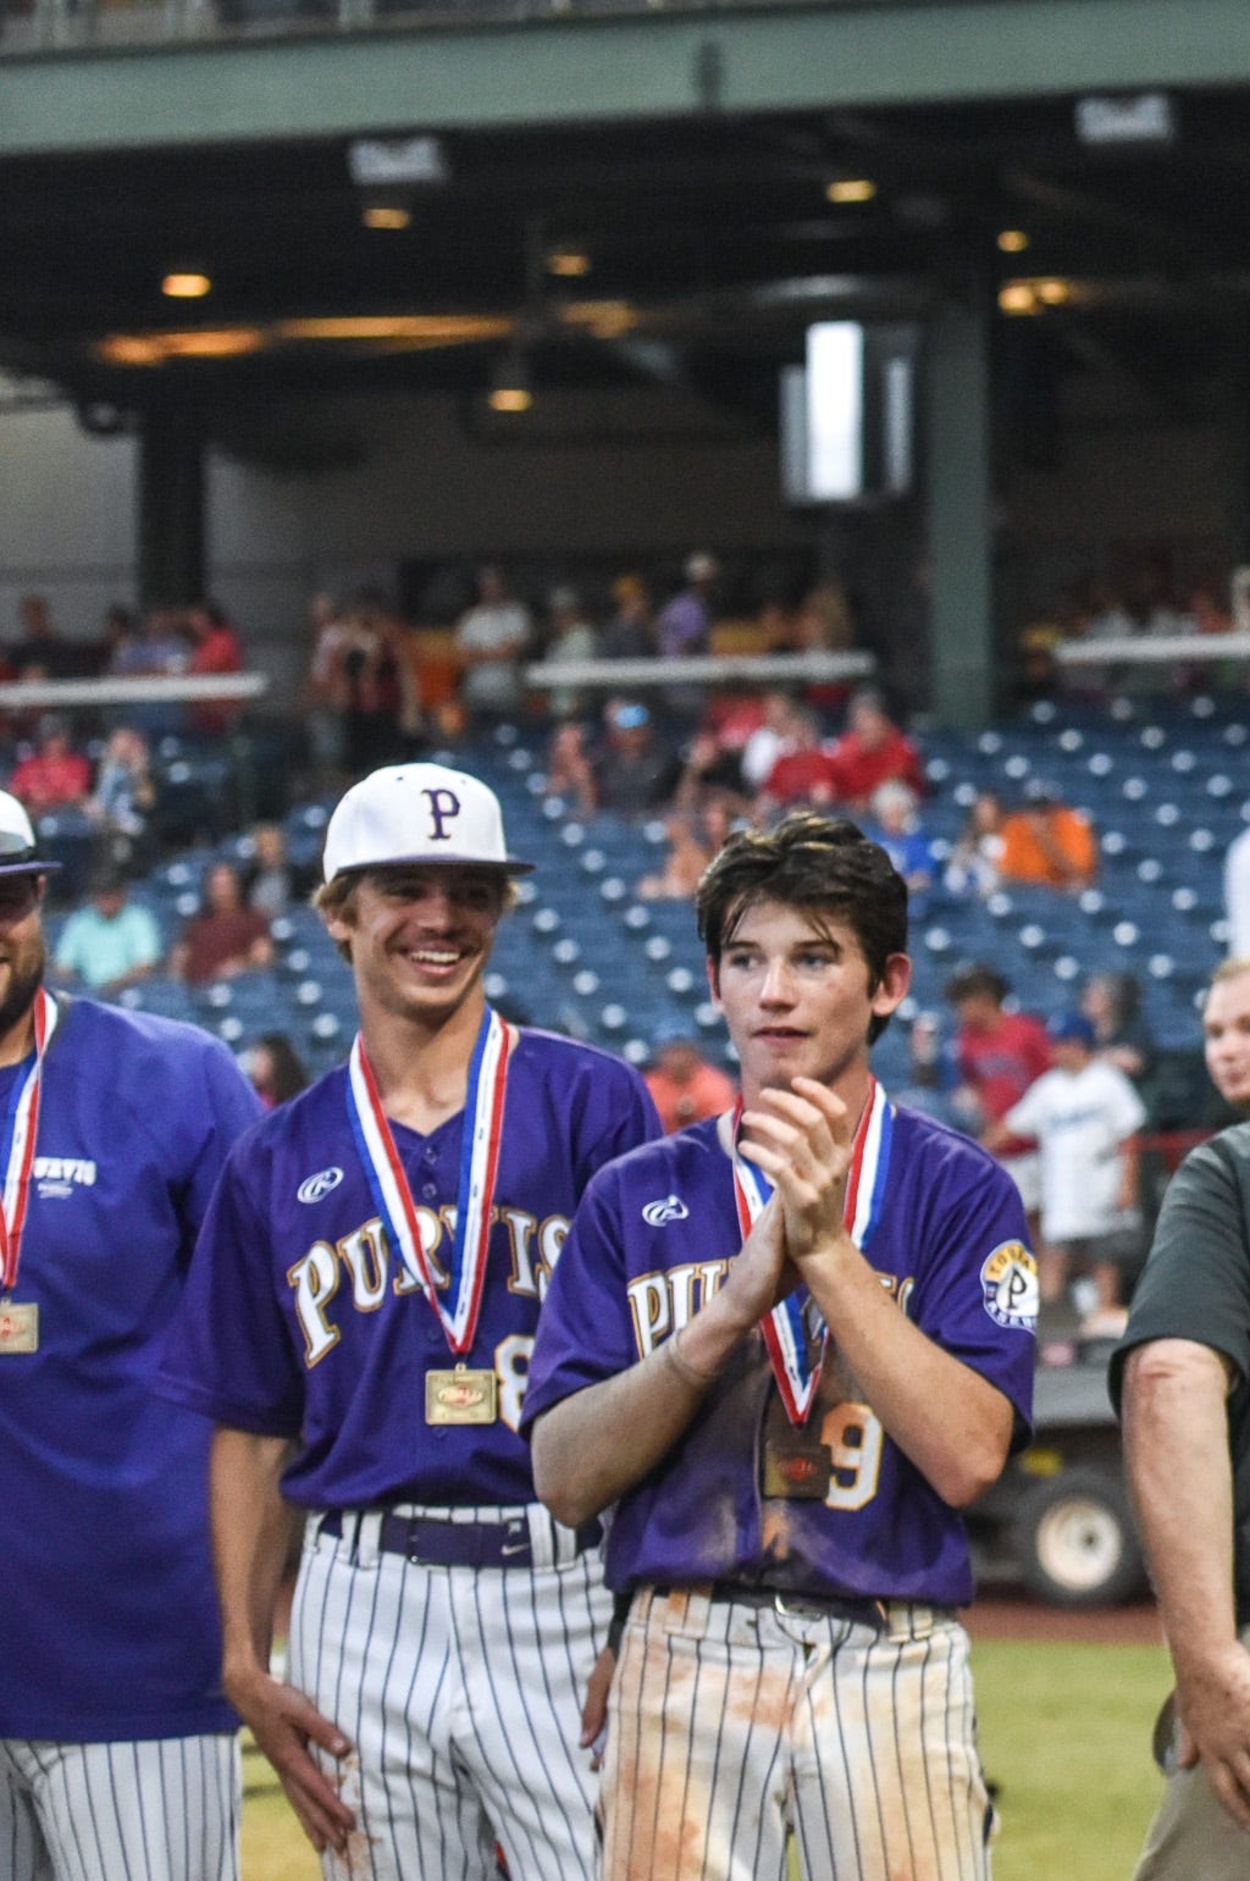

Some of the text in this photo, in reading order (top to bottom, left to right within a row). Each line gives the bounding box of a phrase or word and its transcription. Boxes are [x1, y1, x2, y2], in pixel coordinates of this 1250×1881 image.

[421, 788, 461, 840] P
[1007, 1267, 1028, 1310] P
[819, 1401, 884, 1511] 9
